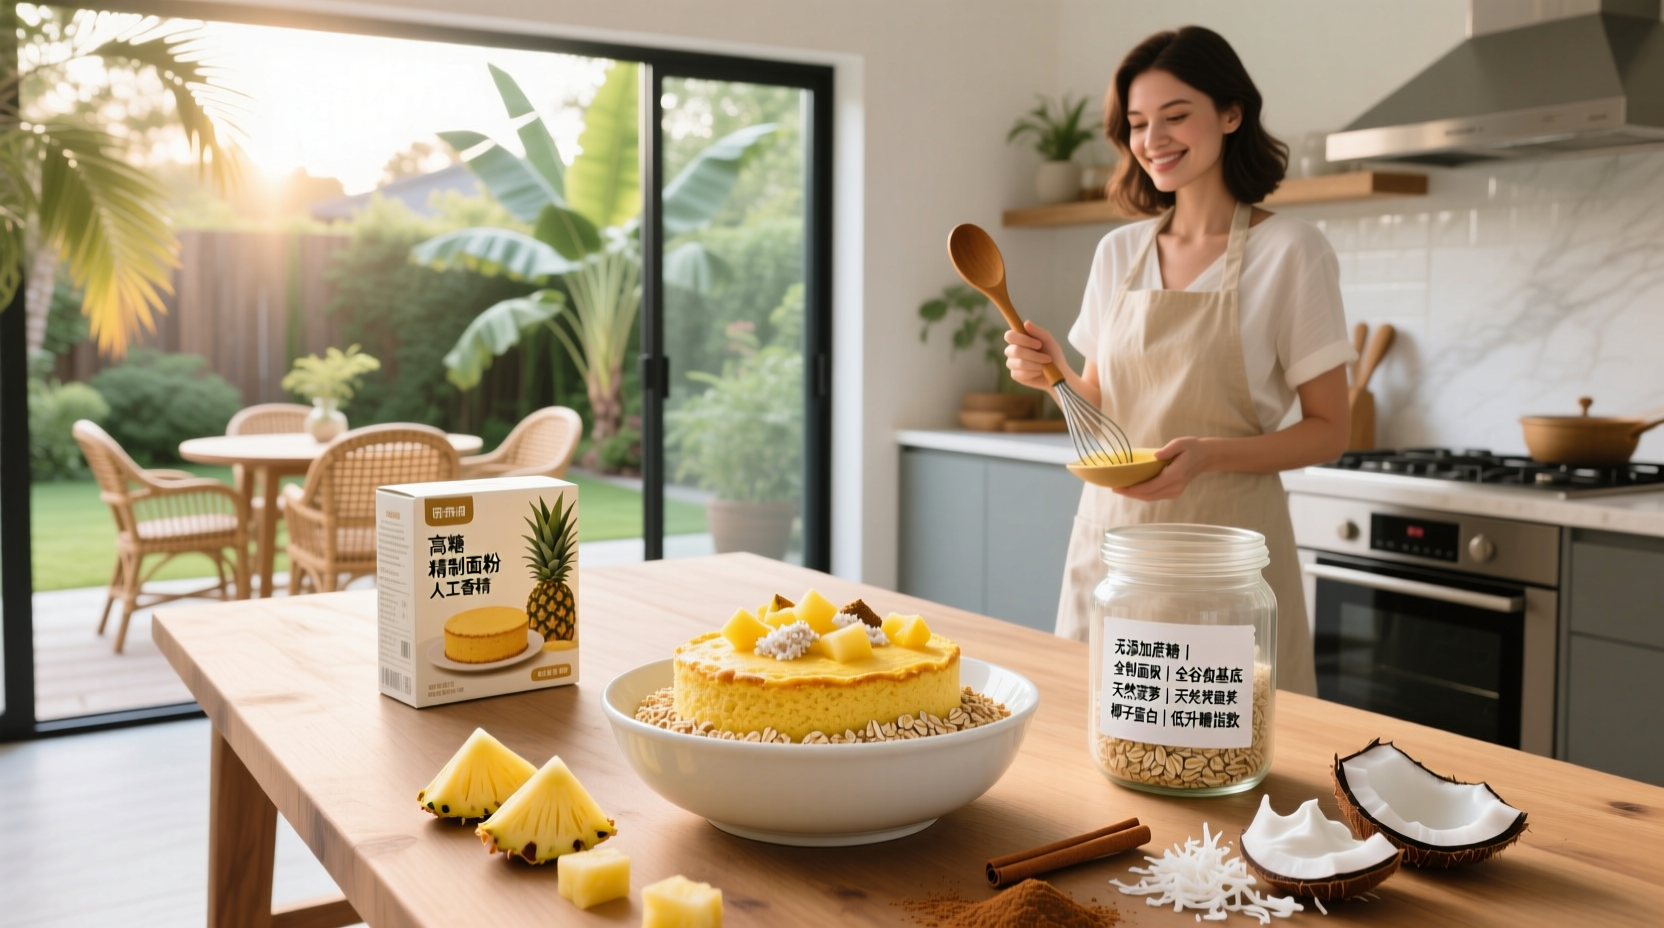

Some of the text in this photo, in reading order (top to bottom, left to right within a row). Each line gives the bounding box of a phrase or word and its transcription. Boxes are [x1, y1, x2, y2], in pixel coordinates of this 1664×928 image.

[427, 534, 465, 556] 高糖
[428, 552, 502, 578] 精制面粉
